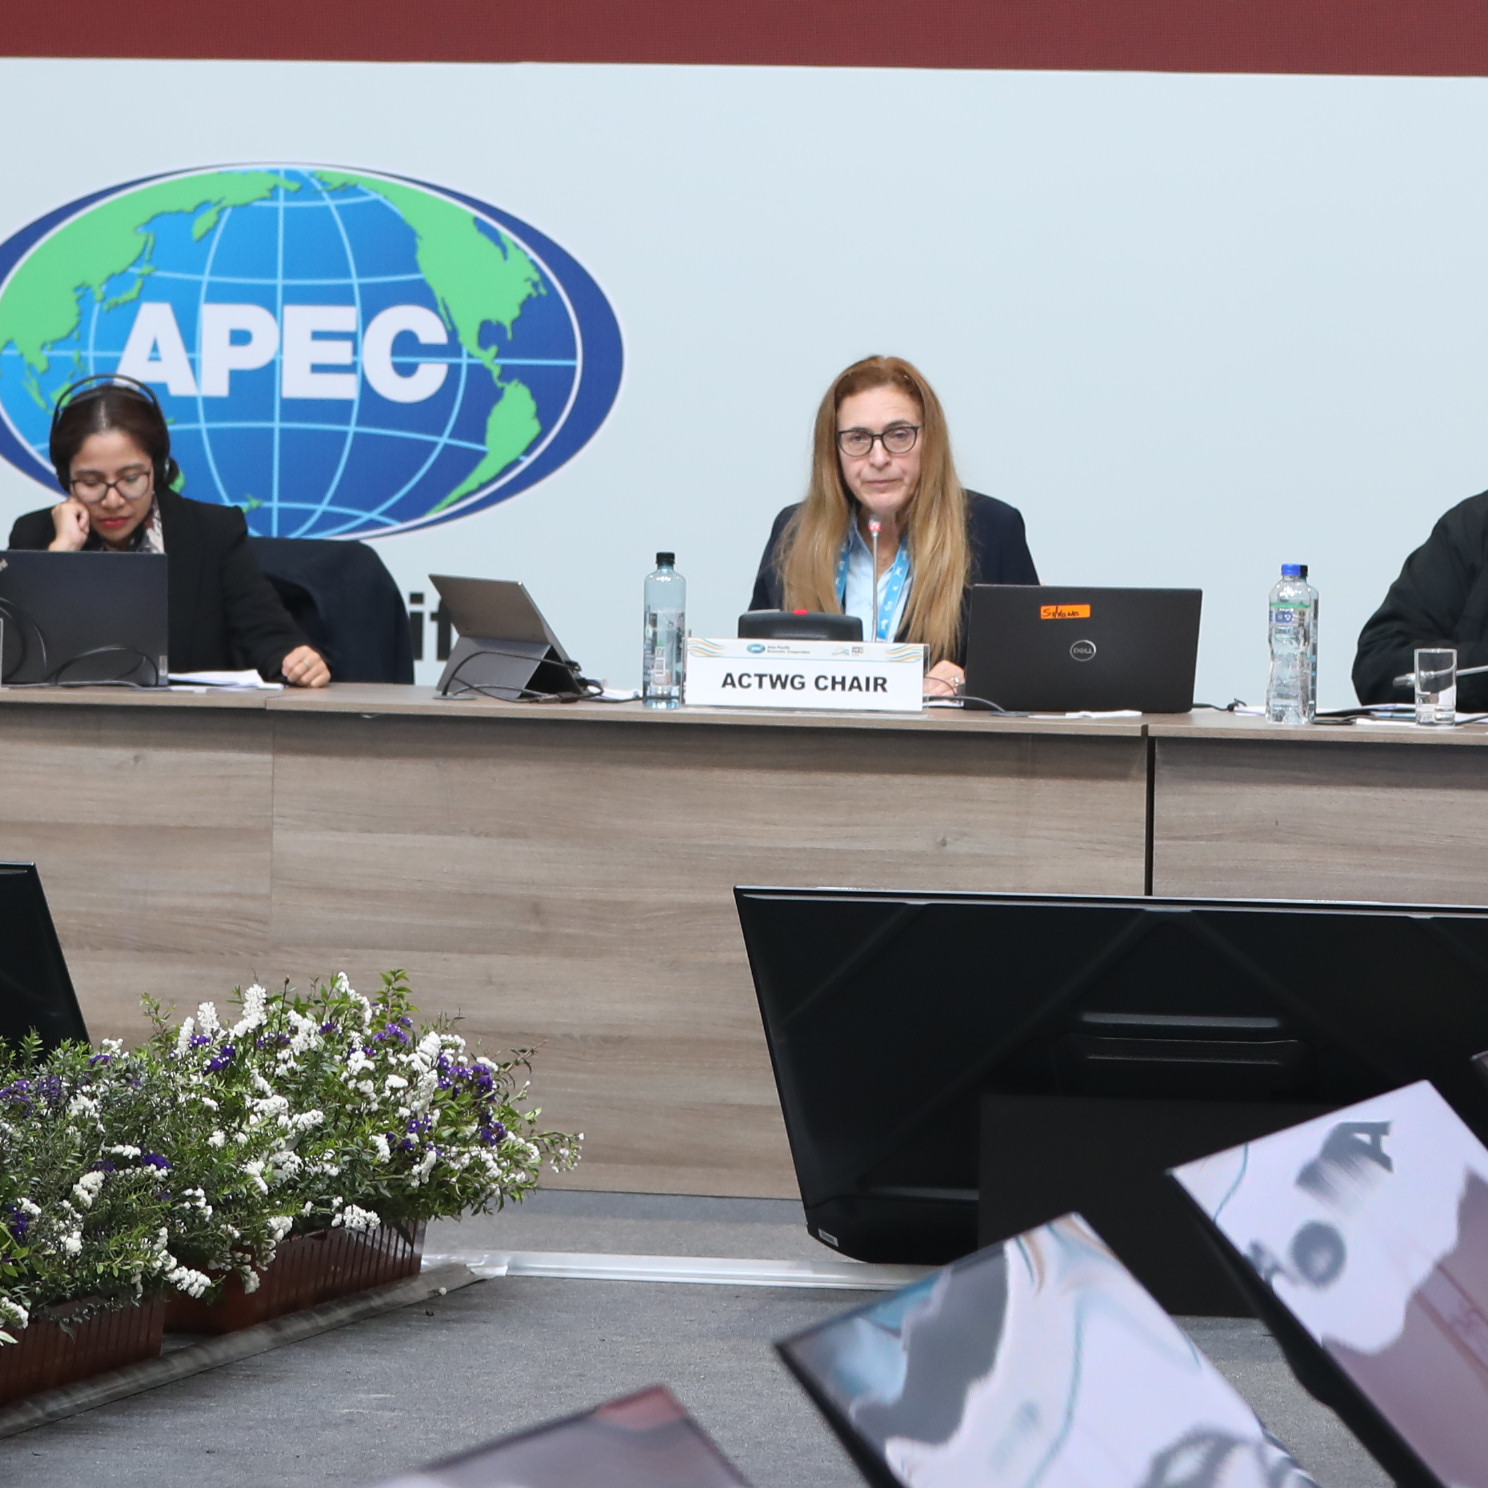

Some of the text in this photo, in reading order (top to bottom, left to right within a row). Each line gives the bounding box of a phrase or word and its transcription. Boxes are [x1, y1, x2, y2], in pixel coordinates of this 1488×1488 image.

[115, 301, 449, 404] APEC
[721, 672, 888, 693] ACTWG CHAIR
